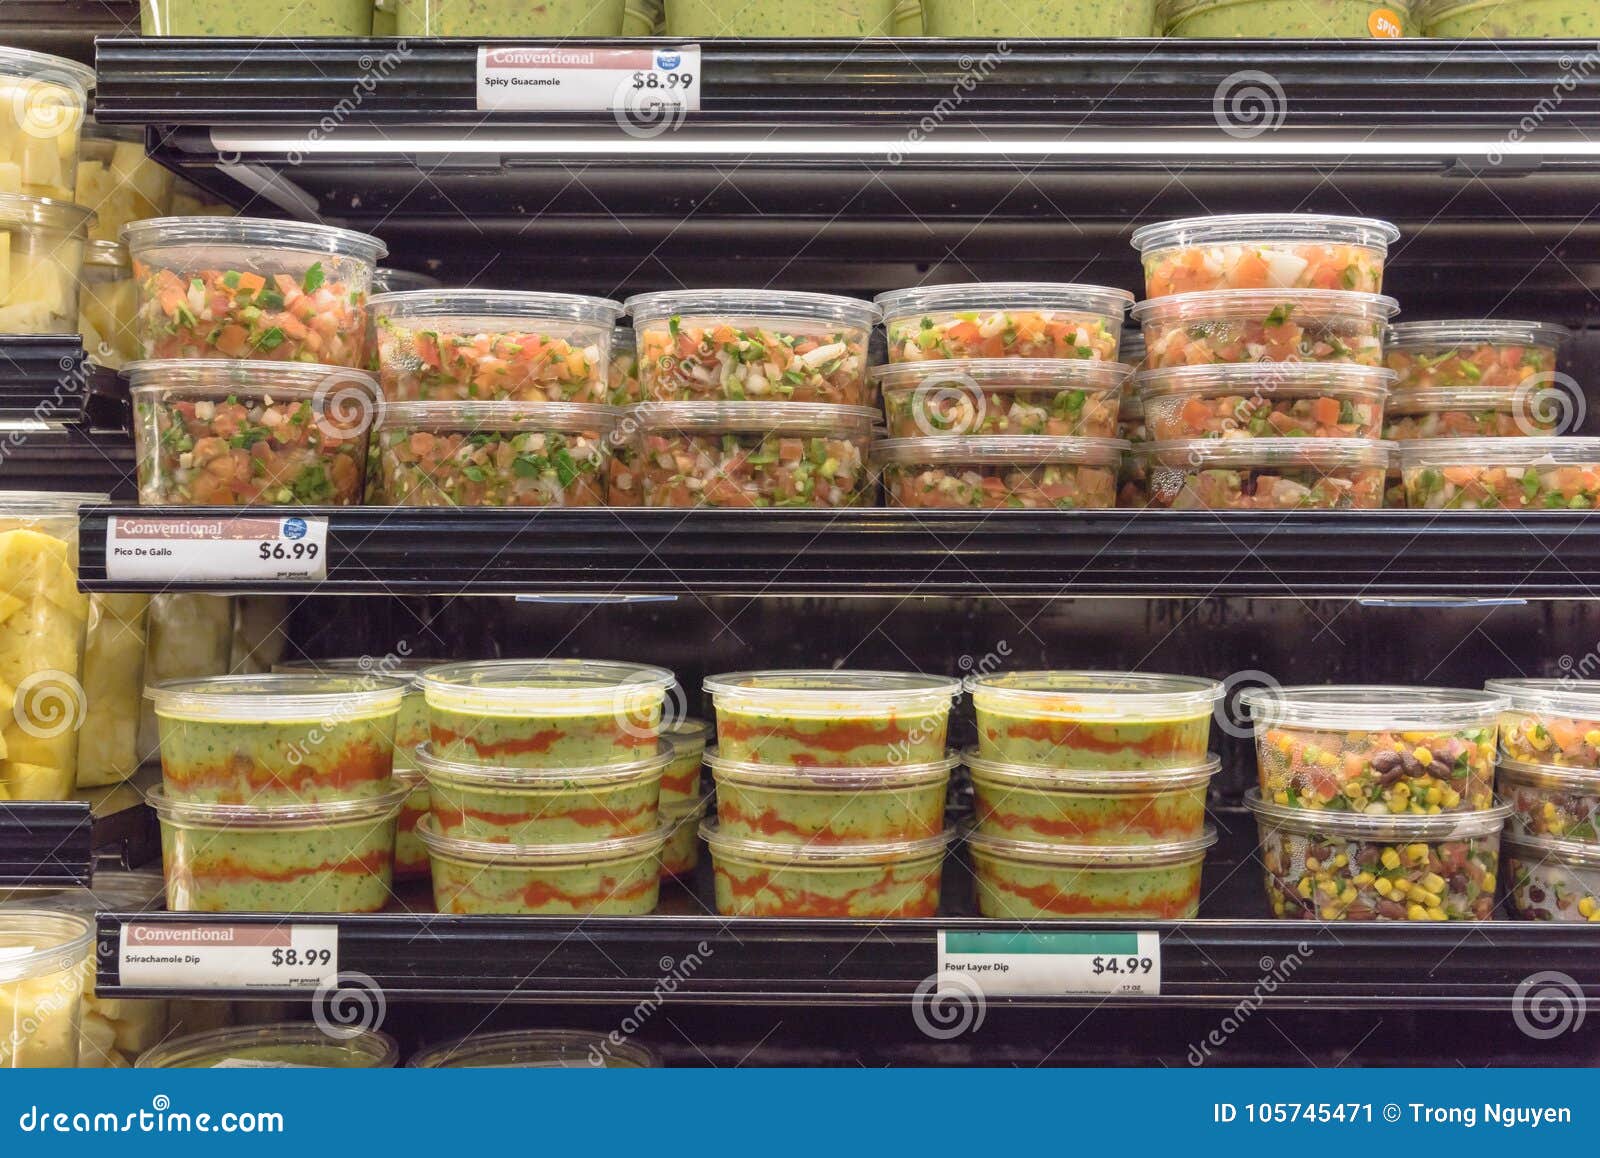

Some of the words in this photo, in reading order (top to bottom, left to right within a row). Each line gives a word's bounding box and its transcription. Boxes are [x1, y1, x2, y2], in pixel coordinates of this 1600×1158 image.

[493, 51, 594, 65] Conventional
[484, 76, 509, 87] Spicy
[510, 76, 561, 86] Guacamole
[632, 71, 693, 90] $8.99
[122, 520, 223, 535] Conventional
[114, 547, 133, 556] Pico
[135, 547, 147, 556] De
[149, 547, 172, 556] Gallo
[259, 542, 319, 560] $6.99
[134, 927, 234, 942] Conventional
[125, 954, 183, 964] Srirachamole
[184, 954, 200, 965] Dip
[271, 947, 332, 967] $8.99
[945, 962, 965, 971] Four
[967, 962, 991, 973] Layer
[993, 962, 1009, 973] Dip
[1092, 956, 1153, 976] $4.99
